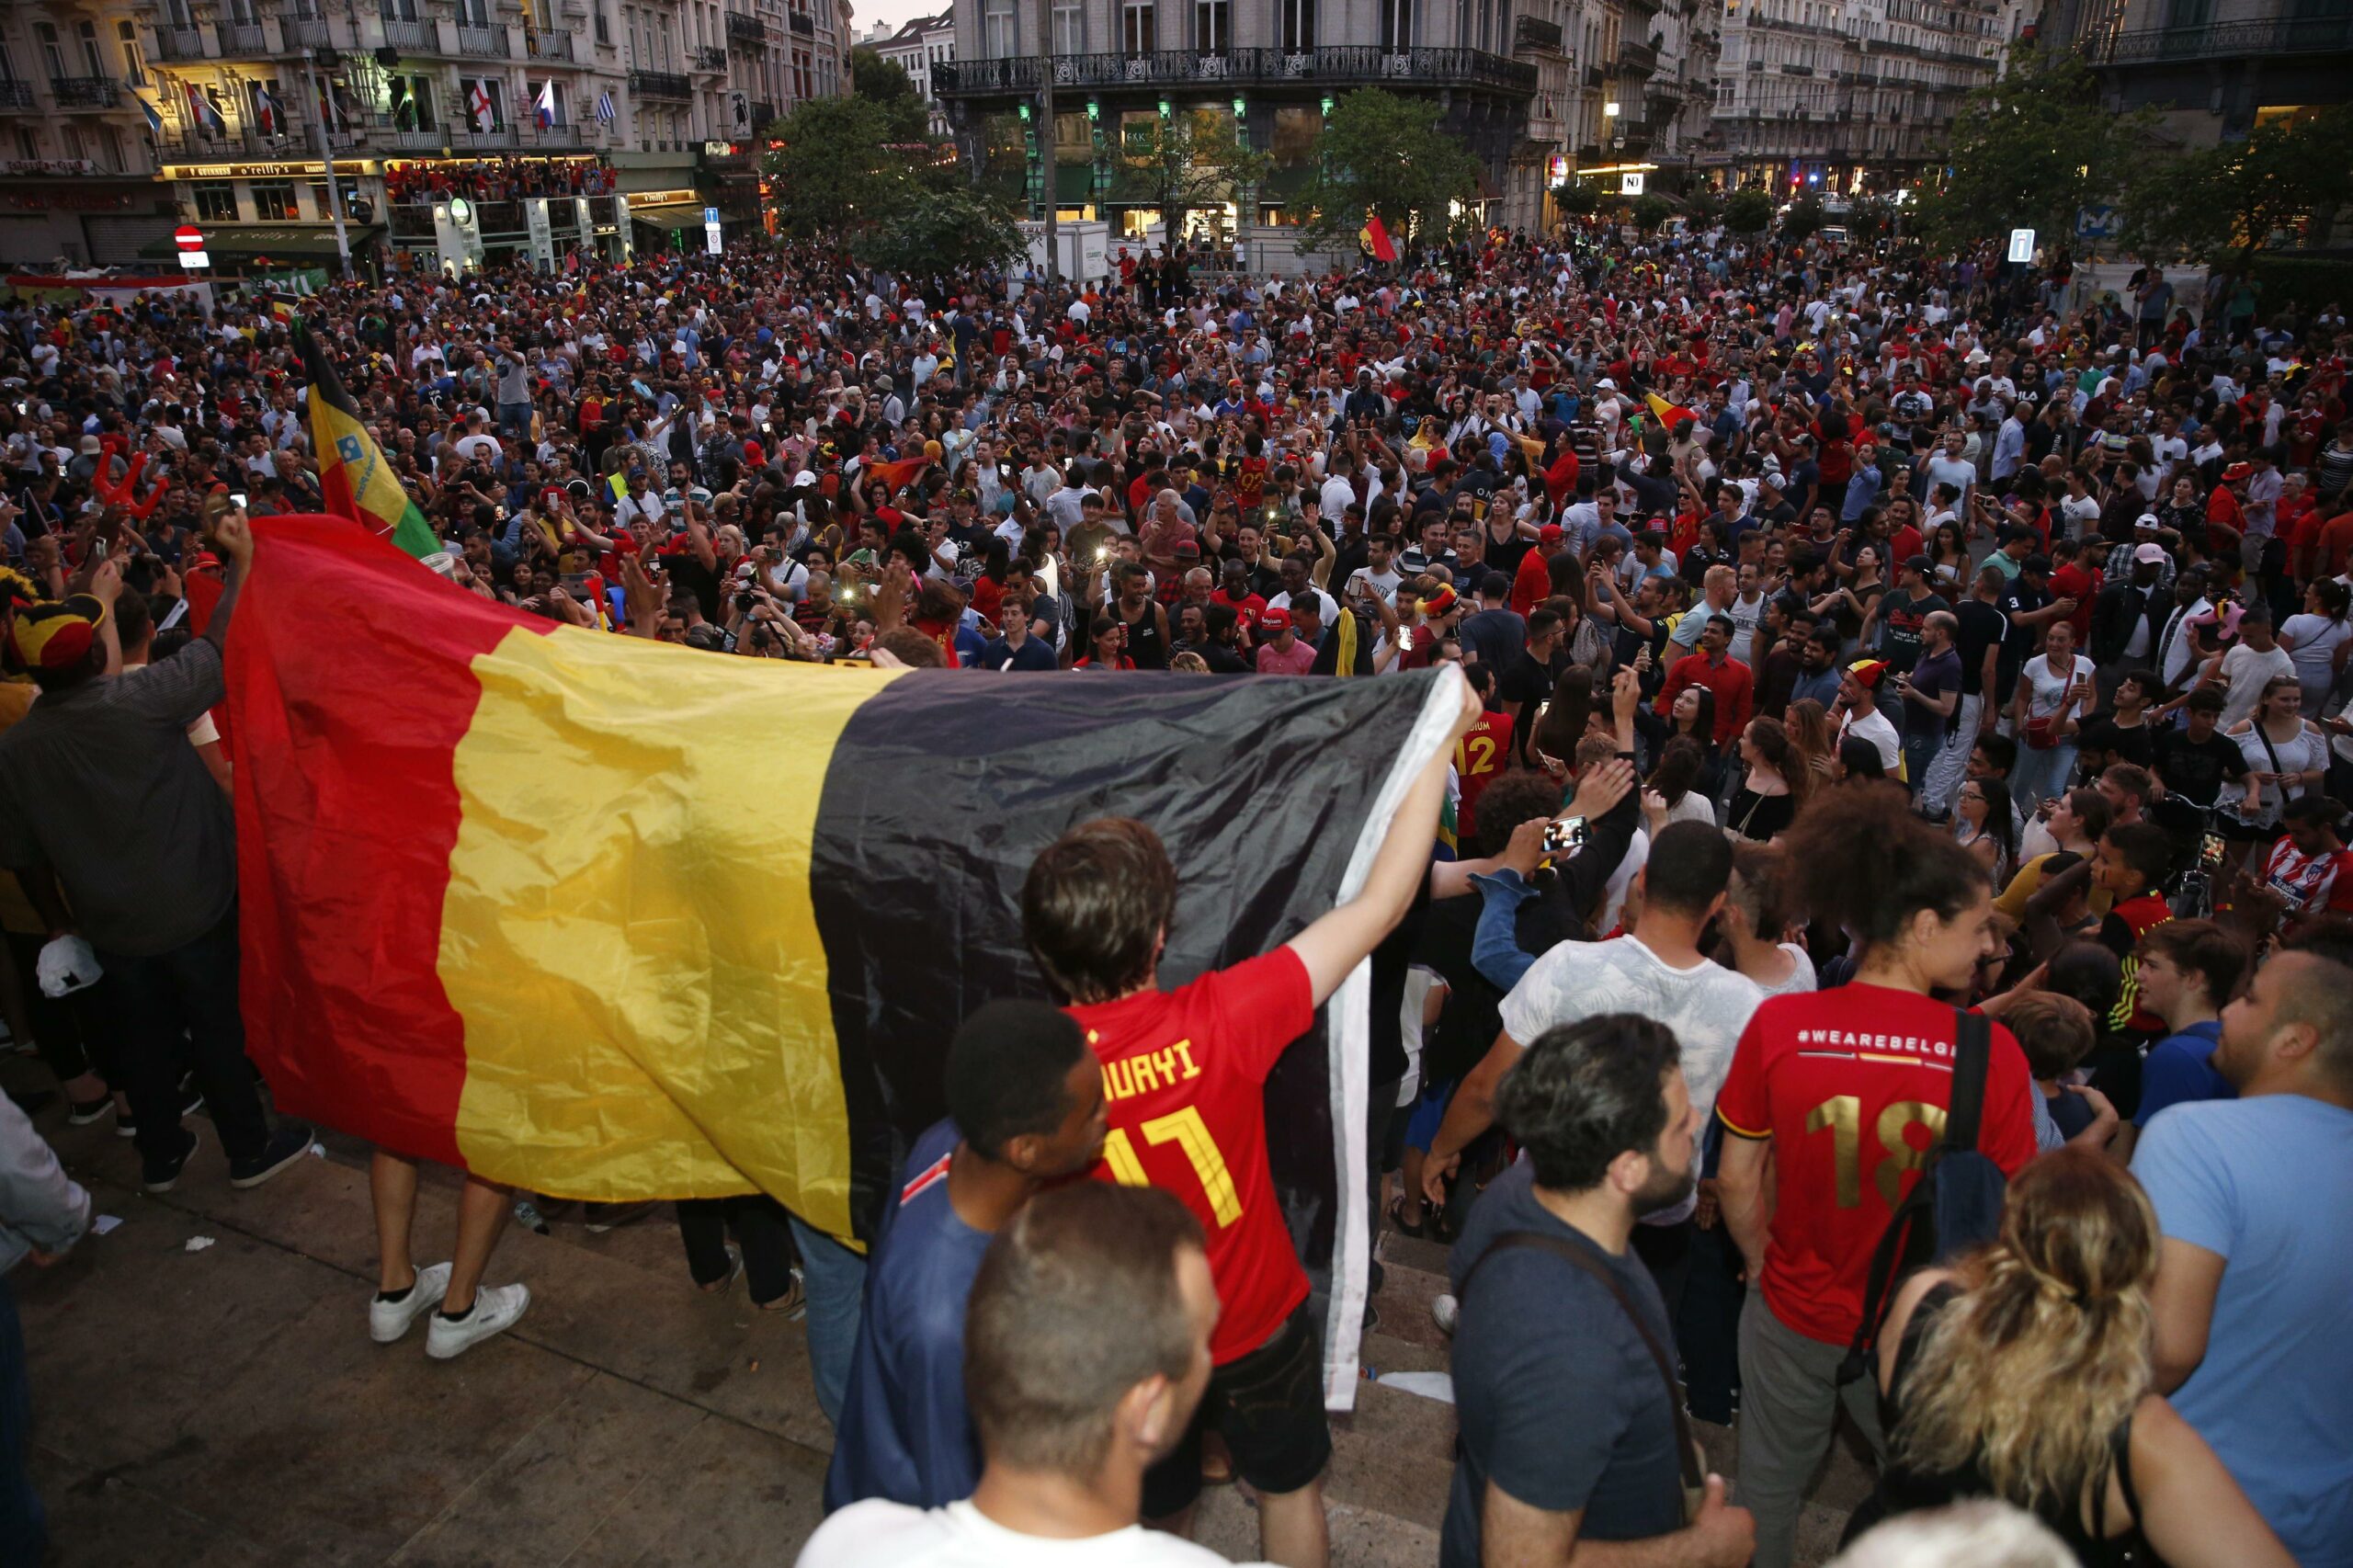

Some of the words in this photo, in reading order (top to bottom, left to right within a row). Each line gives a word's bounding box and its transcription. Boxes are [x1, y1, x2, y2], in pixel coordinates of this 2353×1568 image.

[198, 167, 232, 176] GUINNESS
[241, 165, 290, 176] o'reilly's
[2008, 597, 2019, 608] 3
[1455, 735, 1495, 777] 12
[2275, 878, 2297, 895] Trade
[1103, 1105, 1243, 1230] 17
